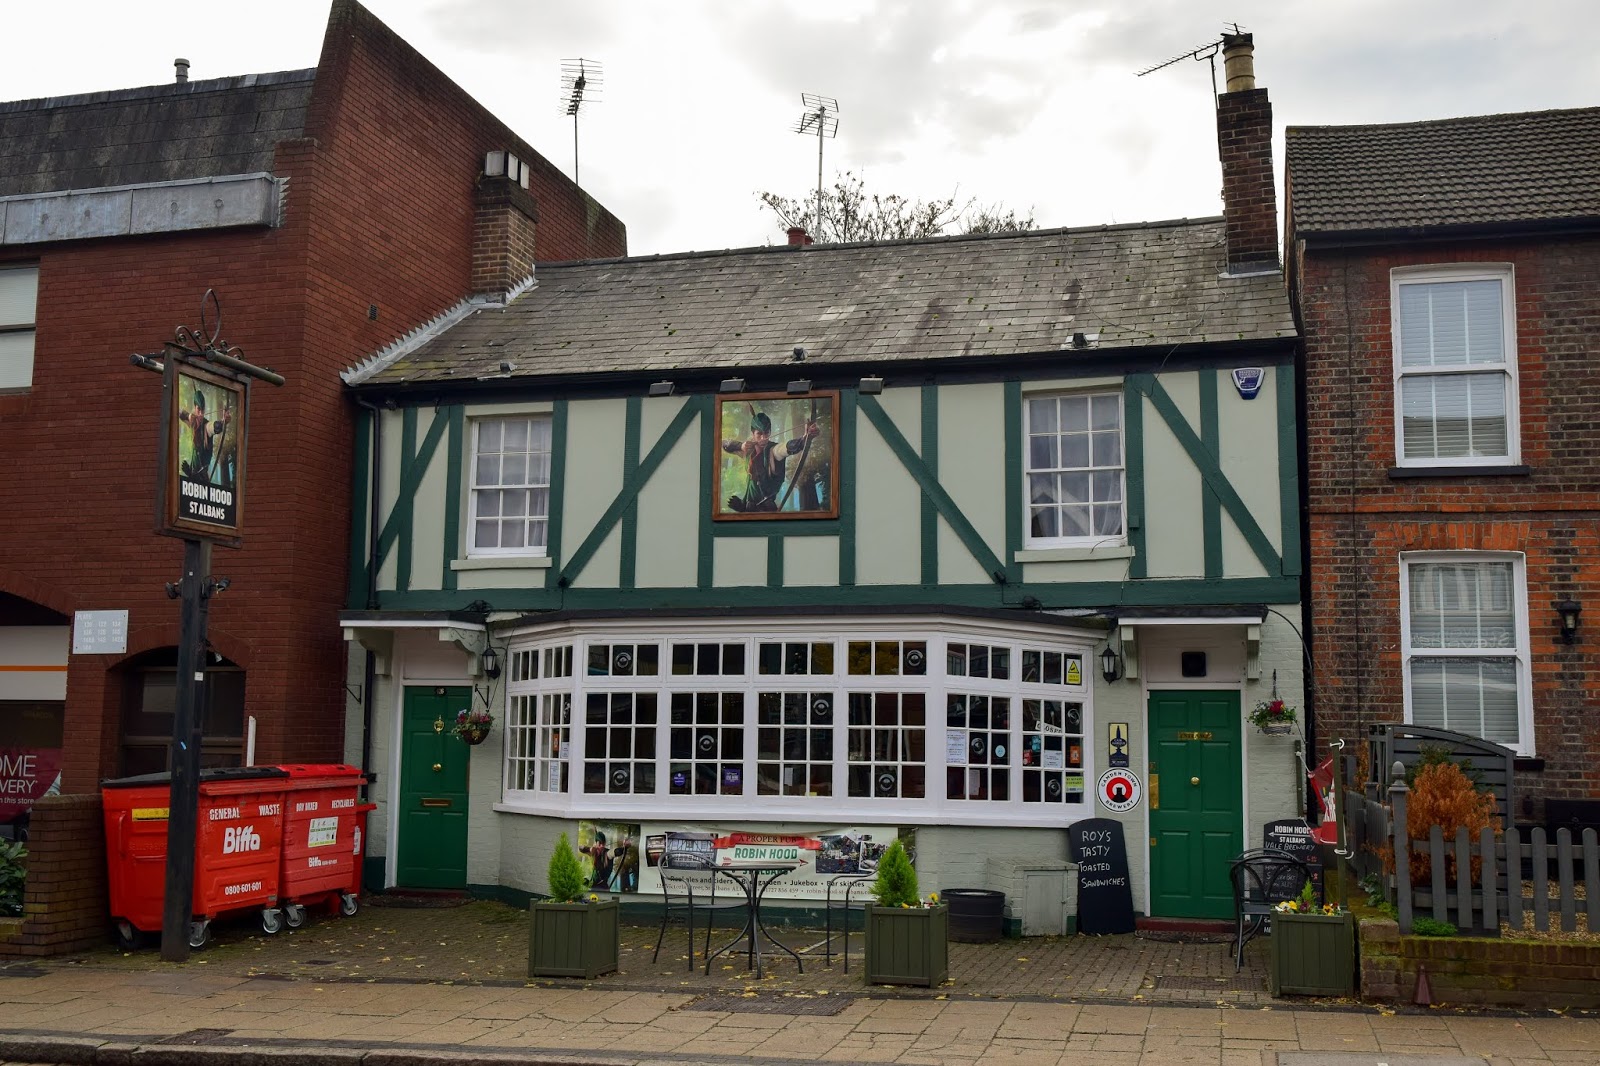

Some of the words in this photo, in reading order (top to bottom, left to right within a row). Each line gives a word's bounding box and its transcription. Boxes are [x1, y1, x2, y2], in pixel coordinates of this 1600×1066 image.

[182, 481, 208, 500] ROBIN
[210, 487, 232, 506] HOOD
[190, 501, 198, 514] ST
[199, 503, 225, 520] ALBANS
[0, 754, 37, 777] ME
[1101, 771, 1121, 787] CAMDEN
[1124, 772, 1137, 787] TOWN
[4, 796, 17, 804] this
[17, 797, 34, 805] store
[1105, 799, 1134, 809] BREWERY
[209, 807, 240, 821] GENERAL
[258, 803, 280, 817] WASTE
[1081, 829, 1111, 842] ROY'S
[1274, 825, 1293, 834] ROBIN
[222, 825, 261, 854] Biffa
[746, 835, 778, 843] PROPER
[1080, 845, 1111, 858] TASTY
[1265, 841, 1282, 850] VALE
[1284, 842, 1316, 852] BREWERY
[734, 847, 767, 859] ROBIN
[768, 848, 798, 860] HOOD
[308, 856, 322, 868] Biffa
[1078, 861, 1111, 873] TOASTED
[699, 876, 712, 884] and
[789, 879, 818, 887] Jukebox
[1081, 877, 1125, 889] SANDWICHES
